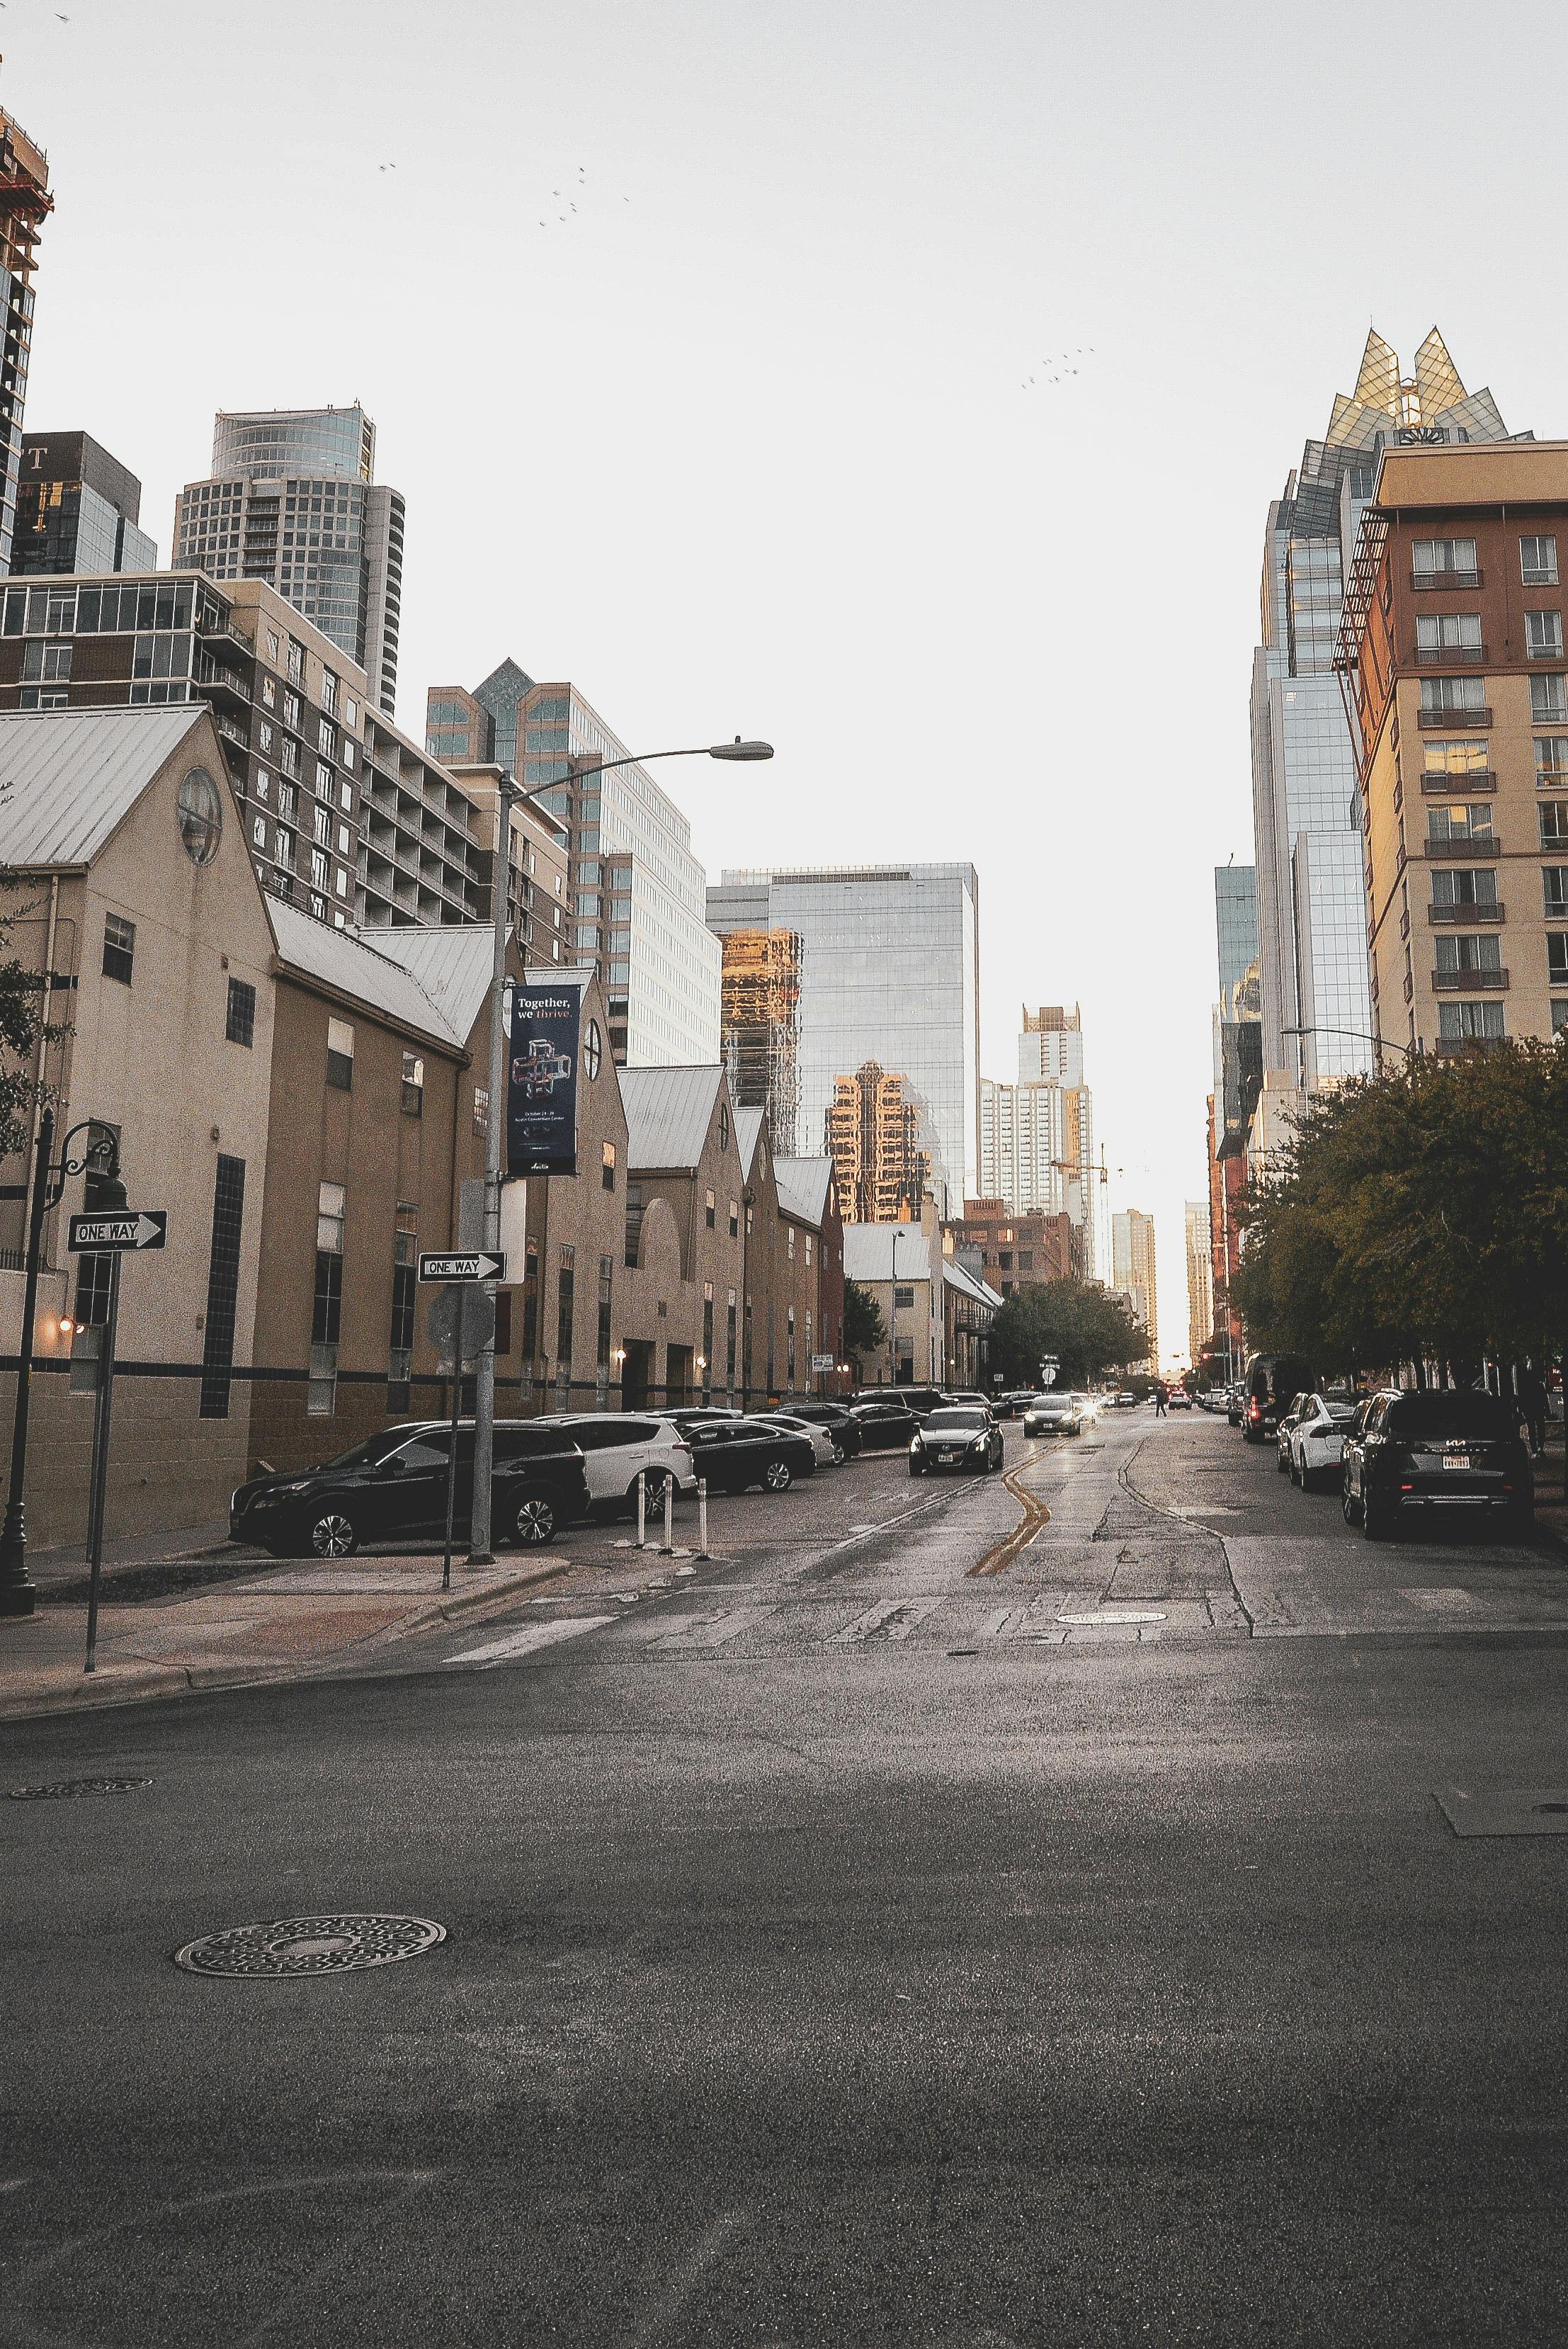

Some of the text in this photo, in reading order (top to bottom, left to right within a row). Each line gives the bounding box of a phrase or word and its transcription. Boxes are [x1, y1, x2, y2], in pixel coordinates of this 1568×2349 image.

[518, 997, 571, 1010] Together,
[79, 1223, 139, 1241] ONE WAY
[429, 1261, 479, 1274] ONE WAY
